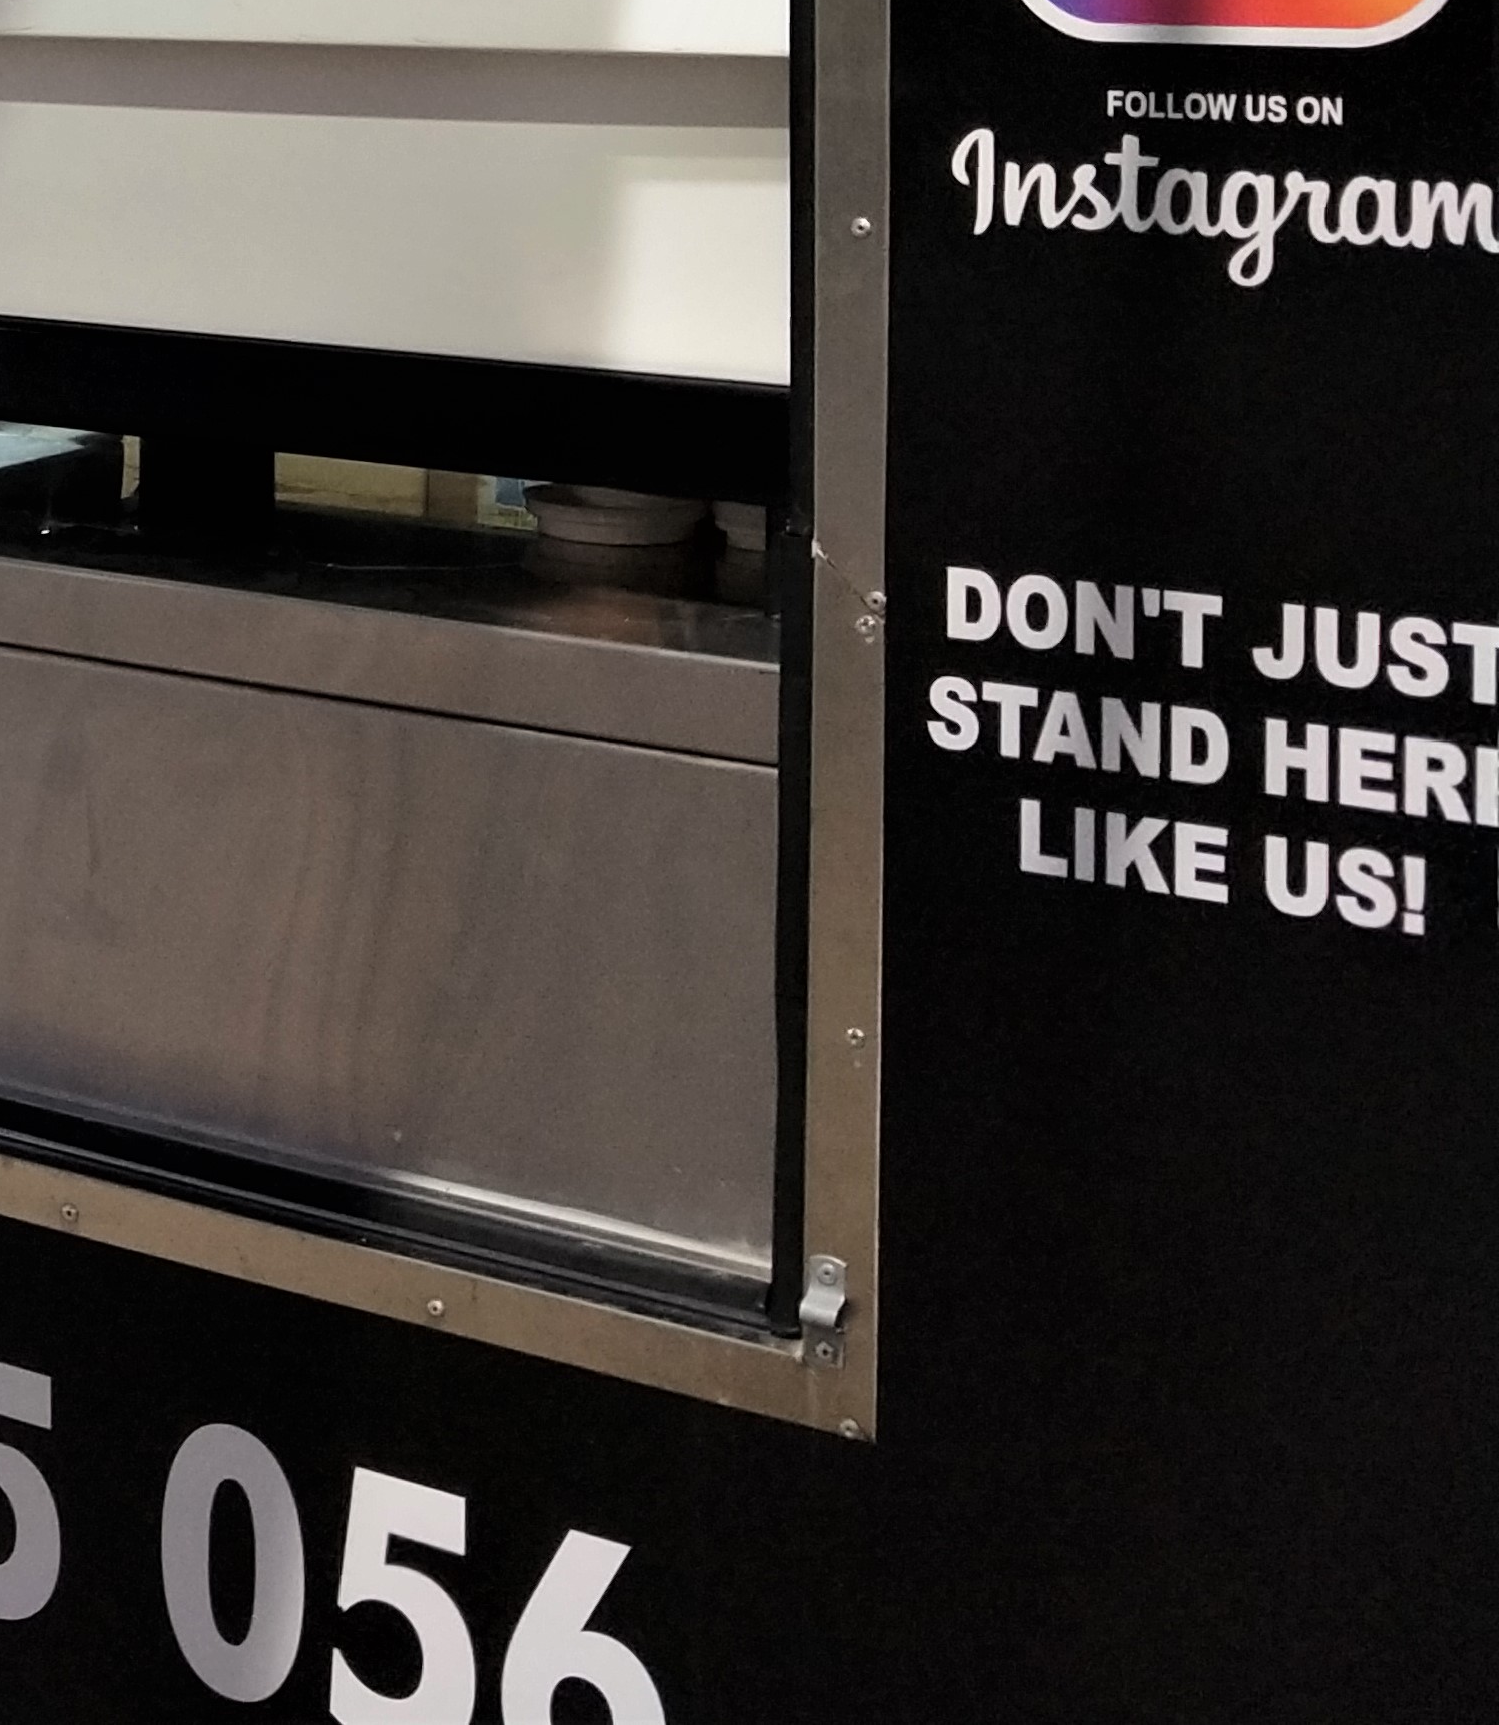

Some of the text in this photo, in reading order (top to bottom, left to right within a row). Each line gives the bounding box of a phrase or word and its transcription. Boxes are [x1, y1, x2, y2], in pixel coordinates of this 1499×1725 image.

[1106, 89, 1344, 126] FOLLOW US ON
[951, 127, 1499, 288] Instagram
[946, 565, 1499, 706] DON'T JUST
[926, 675, 1230, 785] STAND
[1019, 797, 1426, 936] LIKE US!
[161, 1423, 667, 1725] 056
